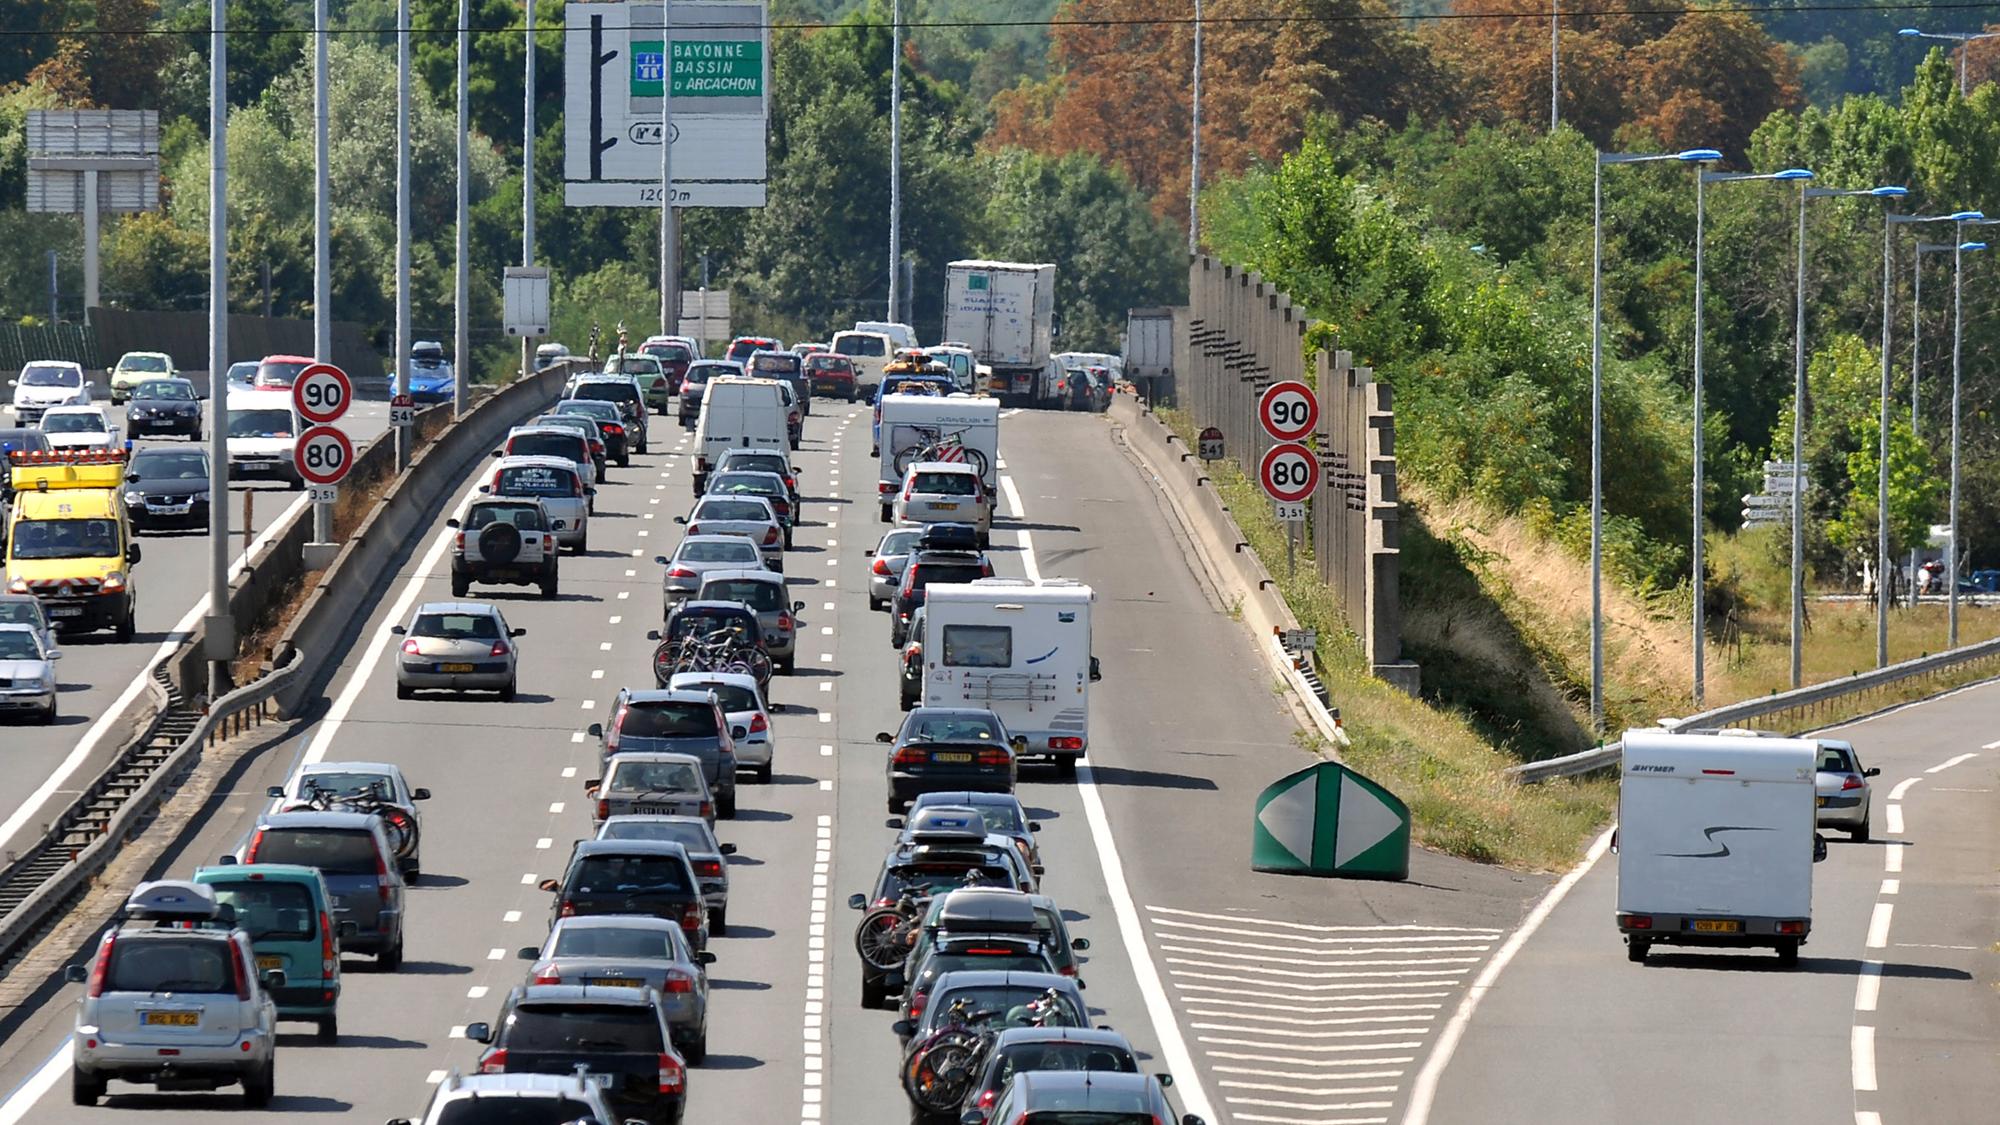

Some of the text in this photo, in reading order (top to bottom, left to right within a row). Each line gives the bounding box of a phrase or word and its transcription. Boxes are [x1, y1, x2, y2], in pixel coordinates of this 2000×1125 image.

[674, 44, 744, 57] BAYONNE
[675, 61, 733, 73] BASSIN
[686, 77, 756, 90] ARCACHON
[306, 383, 341, 407] 90
[391, 411, 414, 422] 541
[1273, 401, 1308, 425] 90
[1200, 443, 1223, 455] 541
[307, 444, 342, 468] 80
[1273, 461, 1308, 486] 80
[1640, 765, 1675, 773] HYMER
